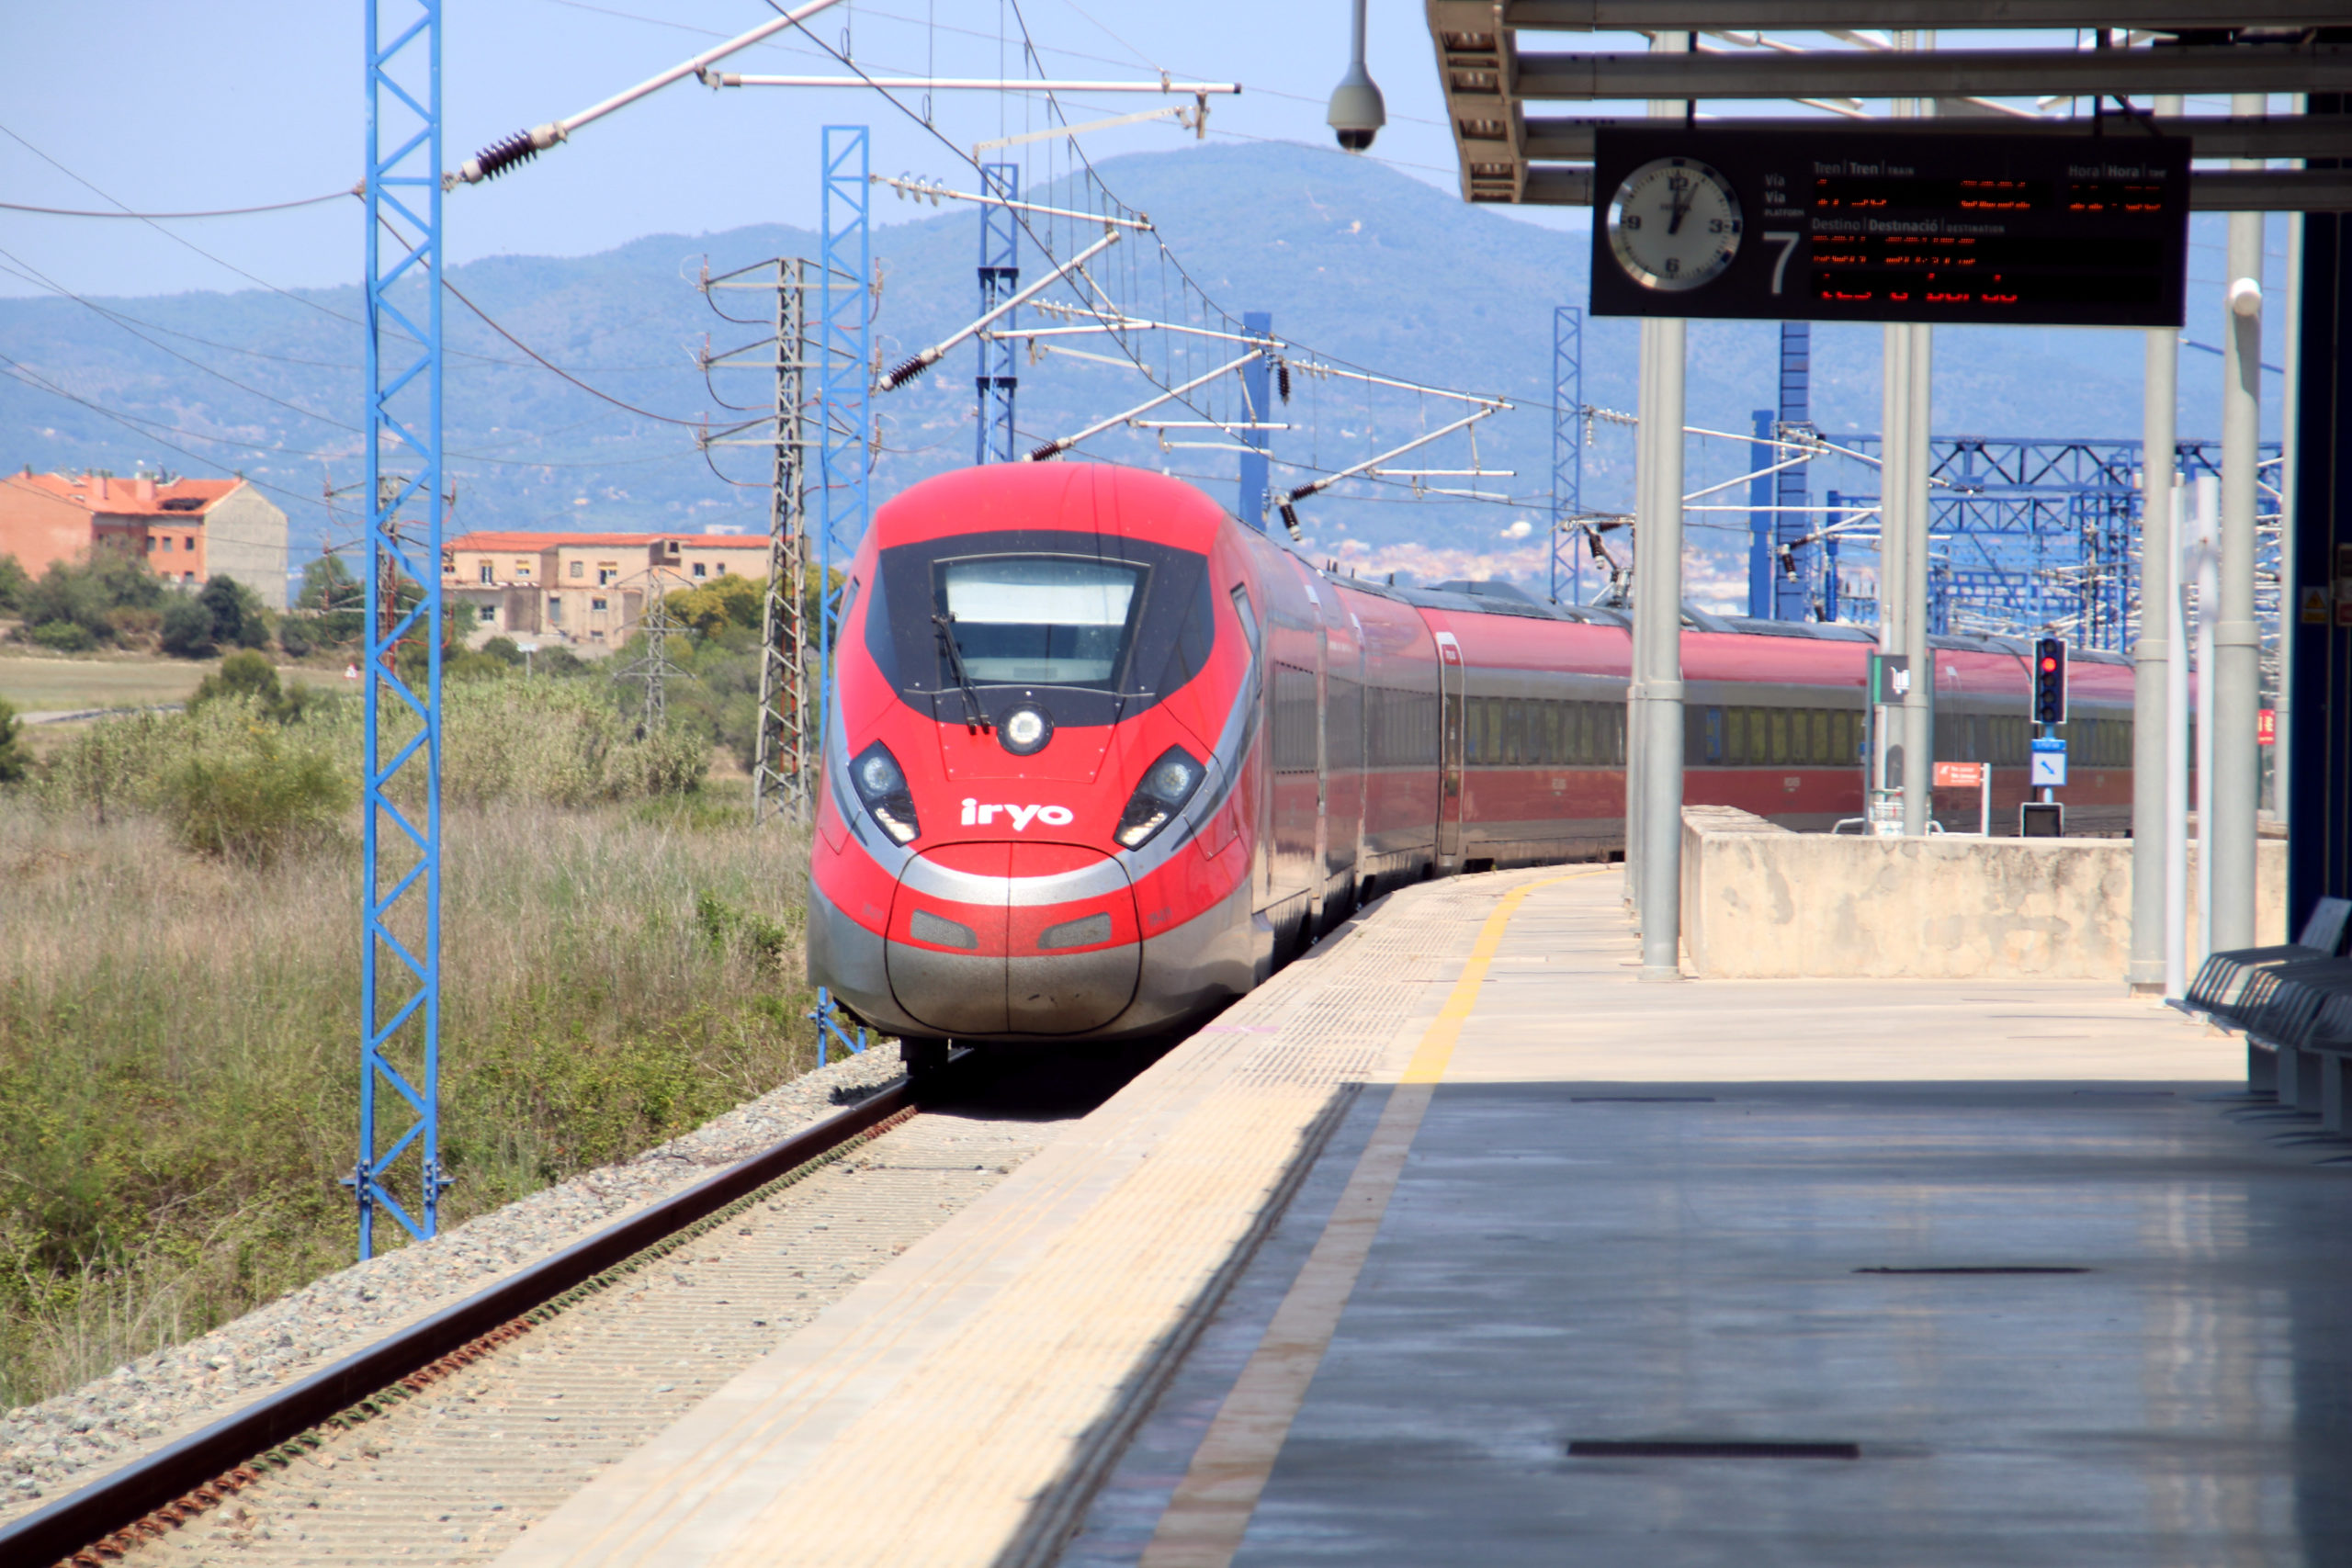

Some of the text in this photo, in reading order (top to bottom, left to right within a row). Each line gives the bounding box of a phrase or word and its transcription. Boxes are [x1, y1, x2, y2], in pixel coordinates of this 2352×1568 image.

[1814, 161, 1842, 175] Tren
[1849, 161, 1880, 175] Tren
[2068, 164, 2100, 178] Hora
[2108, 164, 2141, 178] Hora
[1627, 216, 1642, 231] 9
[1709, 219, 1724, 233] 3
[1811, 217, 1861, 231] Destino
[1868, 217, 1939, 232] Destinació
[1666, 258, 1680, 273] 6
[1762, 230, 1802, 297] 7
[961, 797, 1074, 831] iryo
